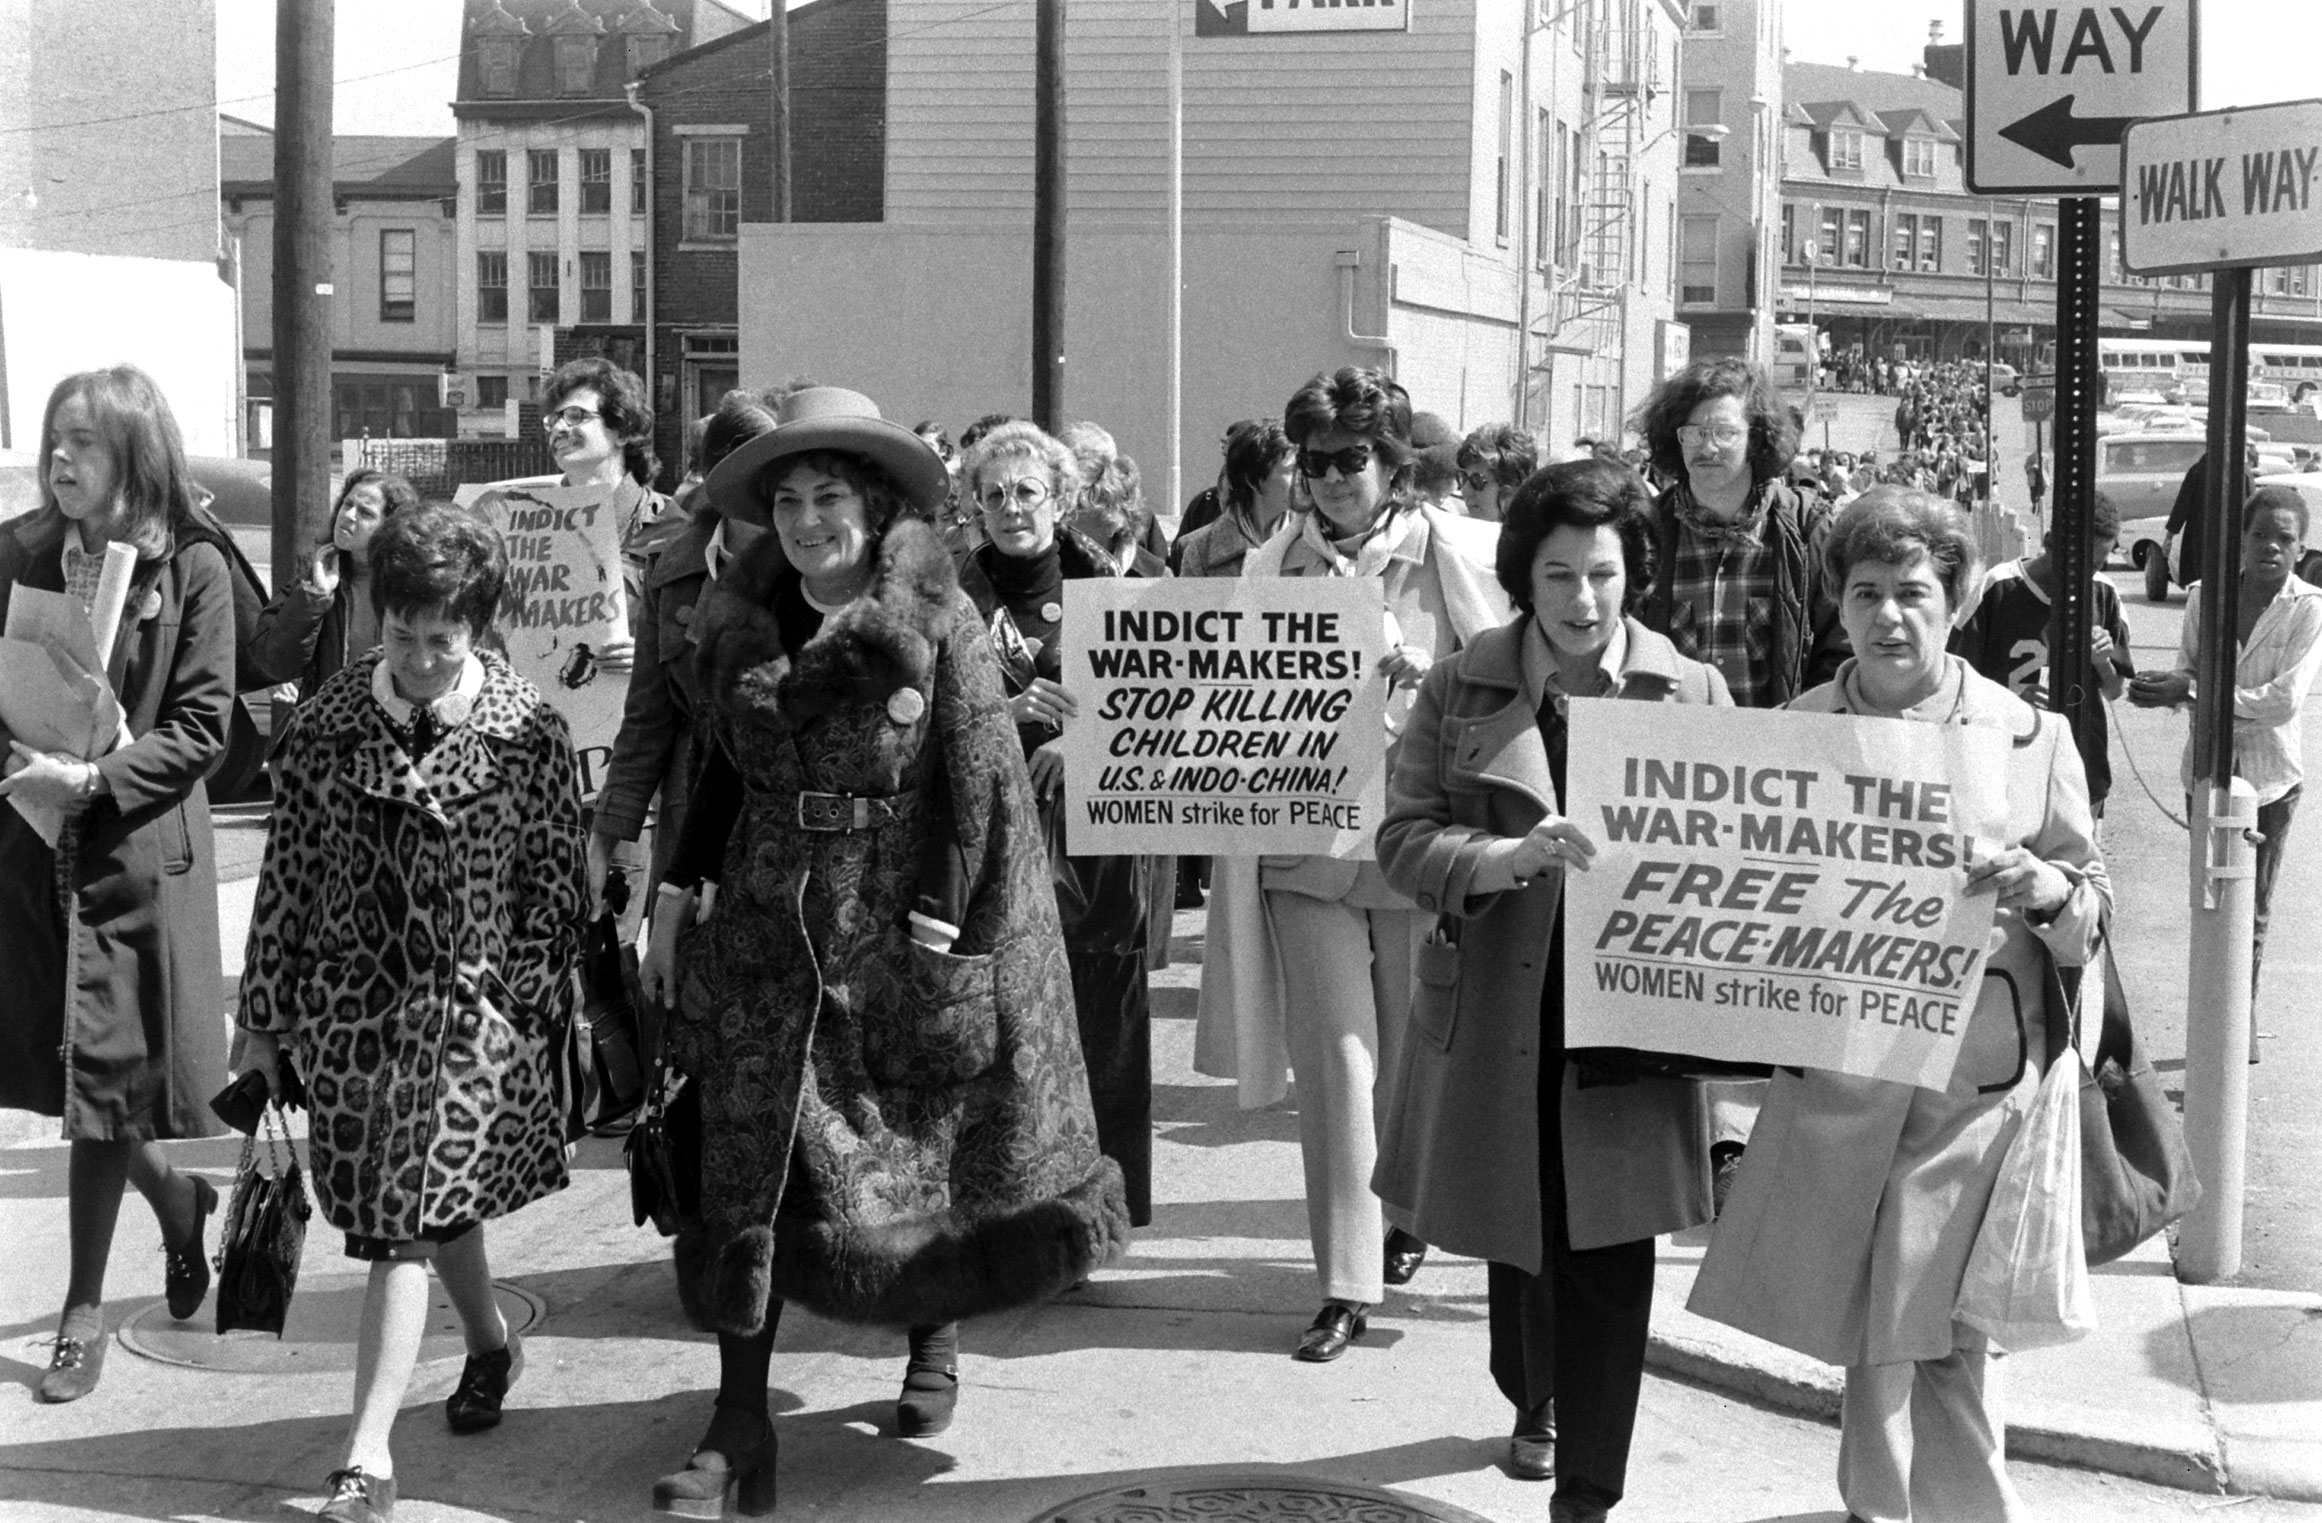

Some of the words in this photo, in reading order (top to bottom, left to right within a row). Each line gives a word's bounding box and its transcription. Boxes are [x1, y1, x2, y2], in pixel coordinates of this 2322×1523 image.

[1999, 6, 2164, 76] WAY
[2139, 157, 2226, 225] WALK
[2242, 147, 2318, 216] WAY
[2024, 400, 2052, 412] STOP
[509, 503, 600, 532] INDICT
[505, 534, 553, 562] THE
[508, 564, 570, 593] WAR
[1104, 610, 1243, 642] INDICT
[1261, 612, 1339, 643] THE
[1098, 687, 1195, 721] STOP
[1201, 688, 1352, 723] KILLING
[1109, 727, 1291, 759] CHILDREN
[1297, 731, 1339, 761] IN
[1098, 766, 1144, 791] U.S.
[1149, 769, 1166, 790] &
[1624, 757, 1818, 810] INDICT
[1844, 774, 1951, 824] THE
[1087, 800, 1173, 825] WOMEN
[1182, 802, 1244, 826] strike
[1249, 803, 1280, 826] for
[1290, 802, 1361, 830] PEACE
[1622, 861, 1820, 915] FREE
[1840, 878, 1944, 929] The
[1595, 962, 1704, 1002] WOMEN
[1715, 977, 1800, 1012] strike
[1809, 982, 1849, 1017] for
[1860, 990, 1960, 1036] PEACE
